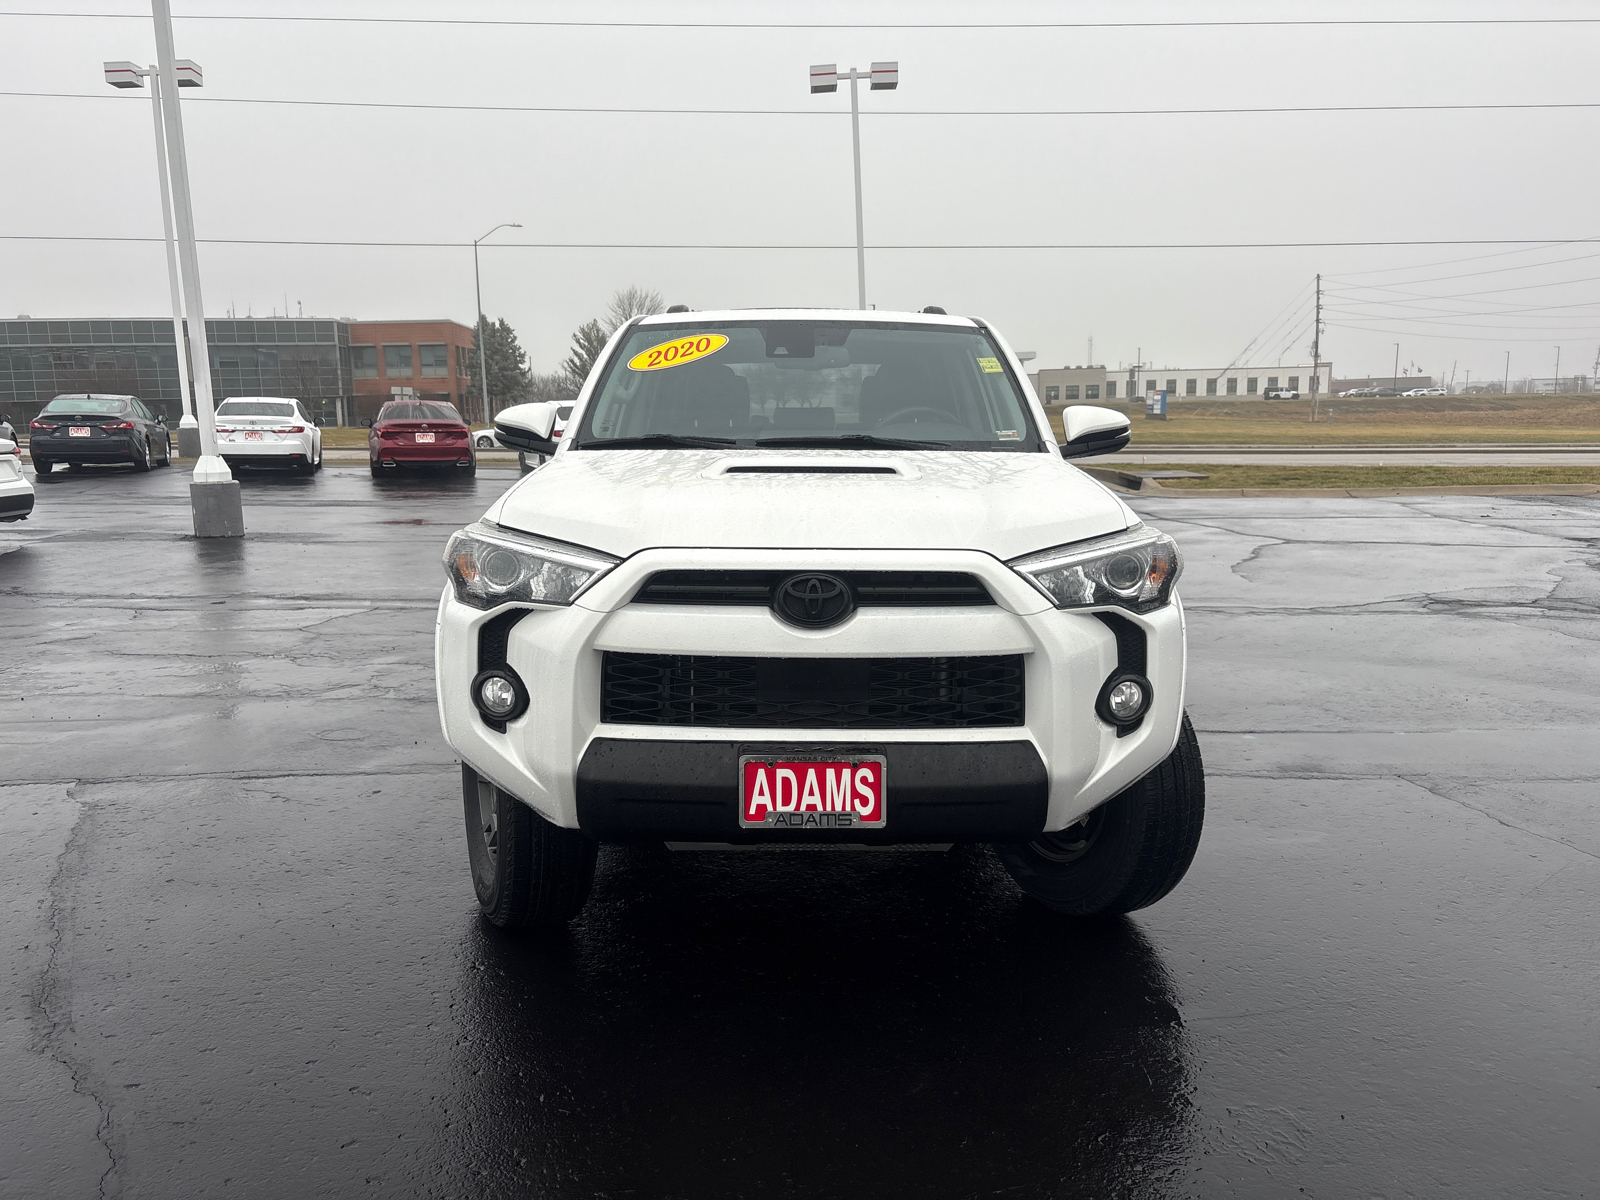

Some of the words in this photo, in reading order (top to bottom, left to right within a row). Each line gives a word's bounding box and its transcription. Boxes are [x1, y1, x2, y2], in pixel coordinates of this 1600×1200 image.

[647, 337, 711, 367] 2020
[70, 427, 90, 436] ADAMS
[749, 767, 875, 816] ADAMS
[774, 813, 853, 827] ADAMS
